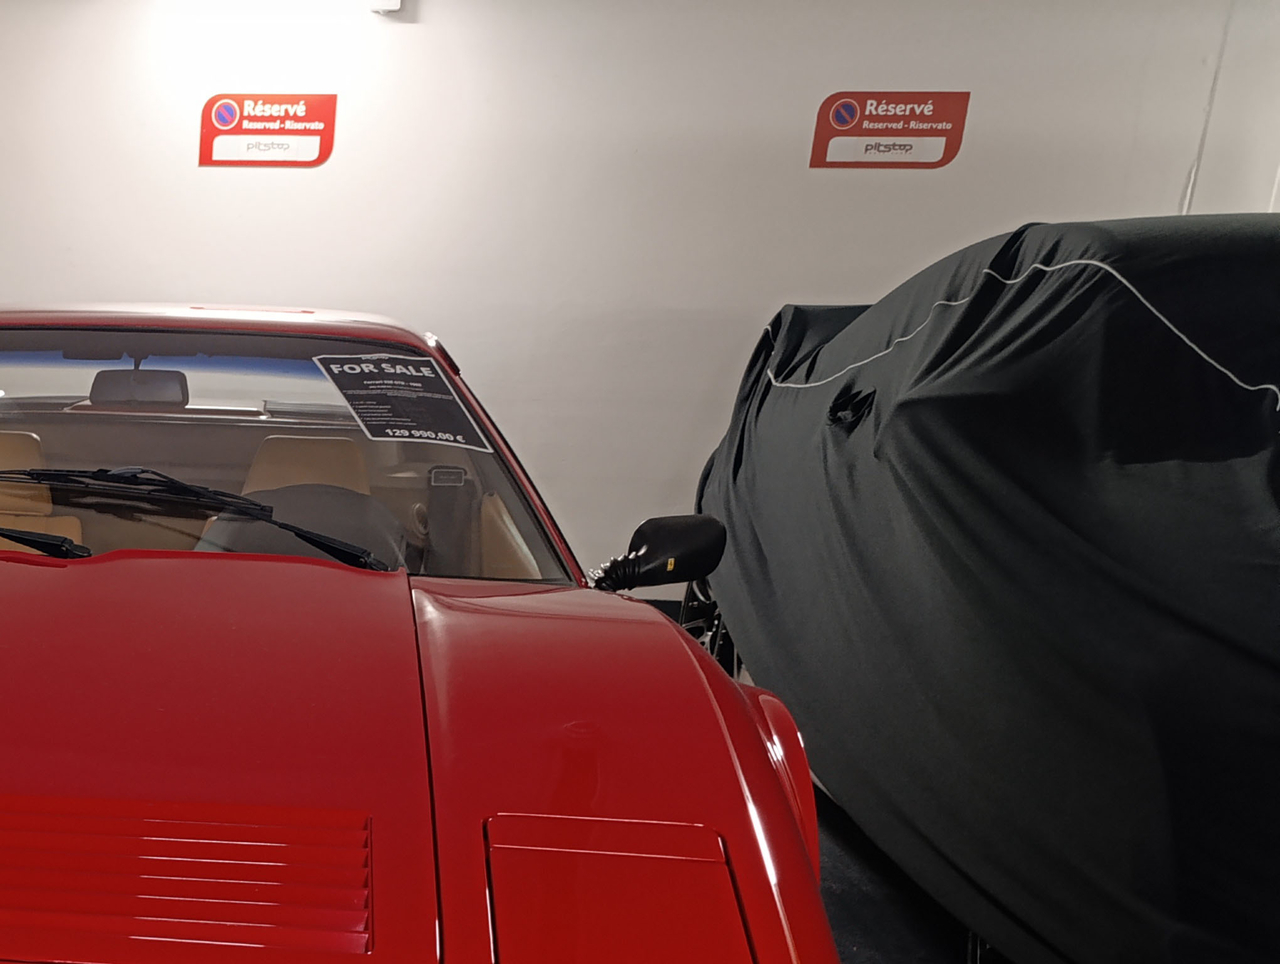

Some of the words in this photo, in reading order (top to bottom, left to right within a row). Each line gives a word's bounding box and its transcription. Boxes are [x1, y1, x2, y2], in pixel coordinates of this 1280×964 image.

[243, 100, 306, 117] Réservé
[865, 100, 934, 116] Réservé
[242, 120, 280, 130] Reserved
[284, 120, 325, 130] Riservato
[862, 120, 903, 129] Reserved
[909, 121, 953, 130] Riservato
[247, 142, 290, 151] pitstop
[864, 142, 913, 154] pitstop
[329, 363, 379, 375] FOR
[380, 363, 436, 378] SALE
[385, 428, 410, 437] 129
[411, 430, 455, 441] 990,00
[456, 435, 466, 443] €
